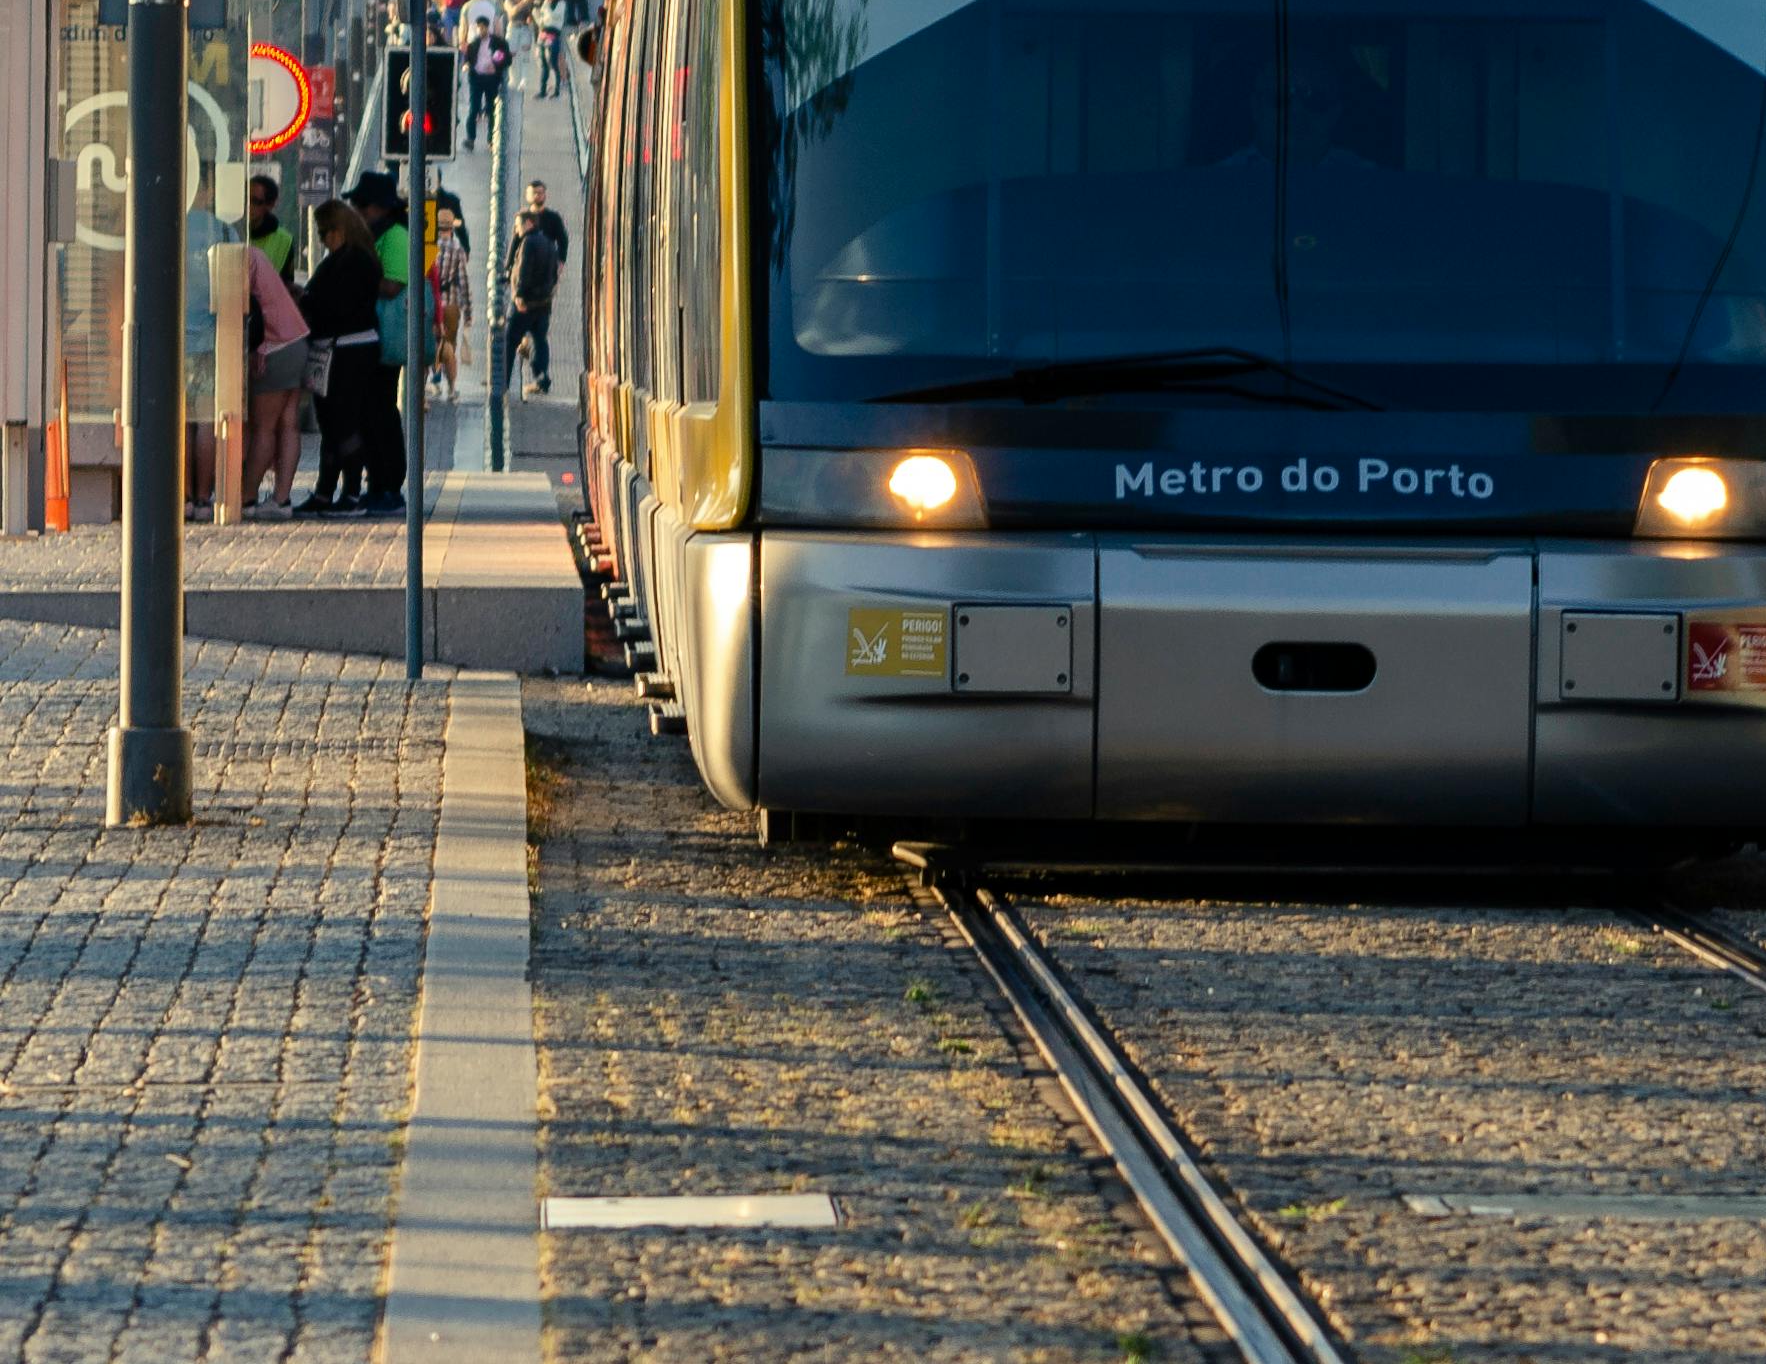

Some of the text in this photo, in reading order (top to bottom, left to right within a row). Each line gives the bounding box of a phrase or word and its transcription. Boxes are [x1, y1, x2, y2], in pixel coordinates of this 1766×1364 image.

[1115, 457, 1494, 499] Metro do Porto
